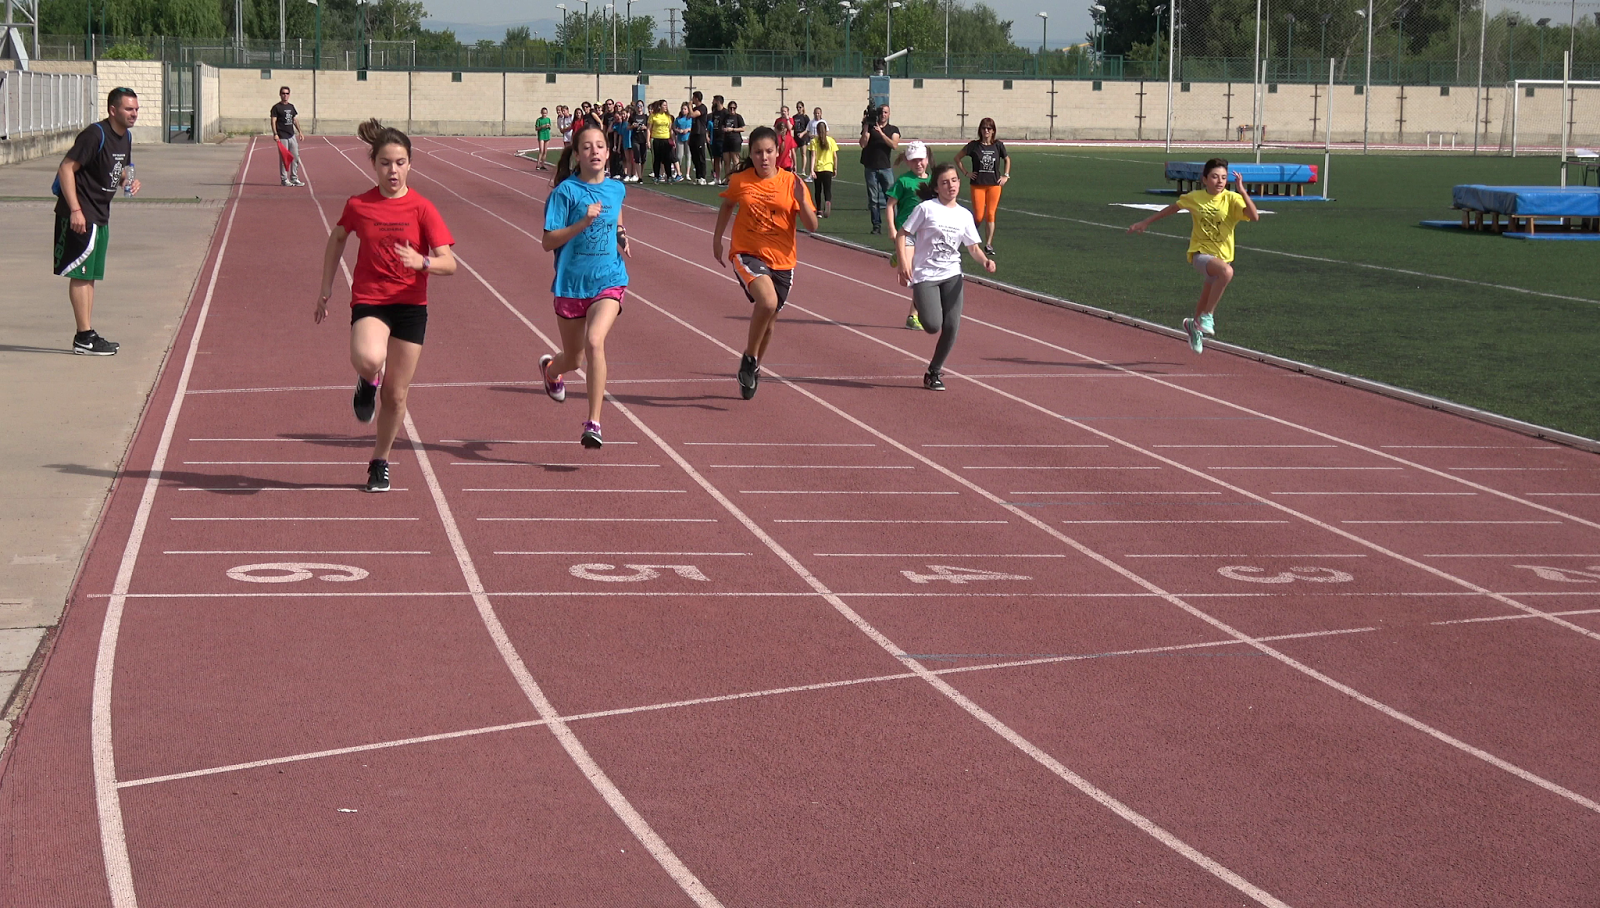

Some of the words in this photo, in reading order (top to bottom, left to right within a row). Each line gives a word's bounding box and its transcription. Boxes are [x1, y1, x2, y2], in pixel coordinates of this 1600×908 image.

[226, 562, 370, 583] 6
[568, 563, 711, 582] 5
[900, 565, 1033, 583] 4
[1217, 566, 1354, 583] 3
